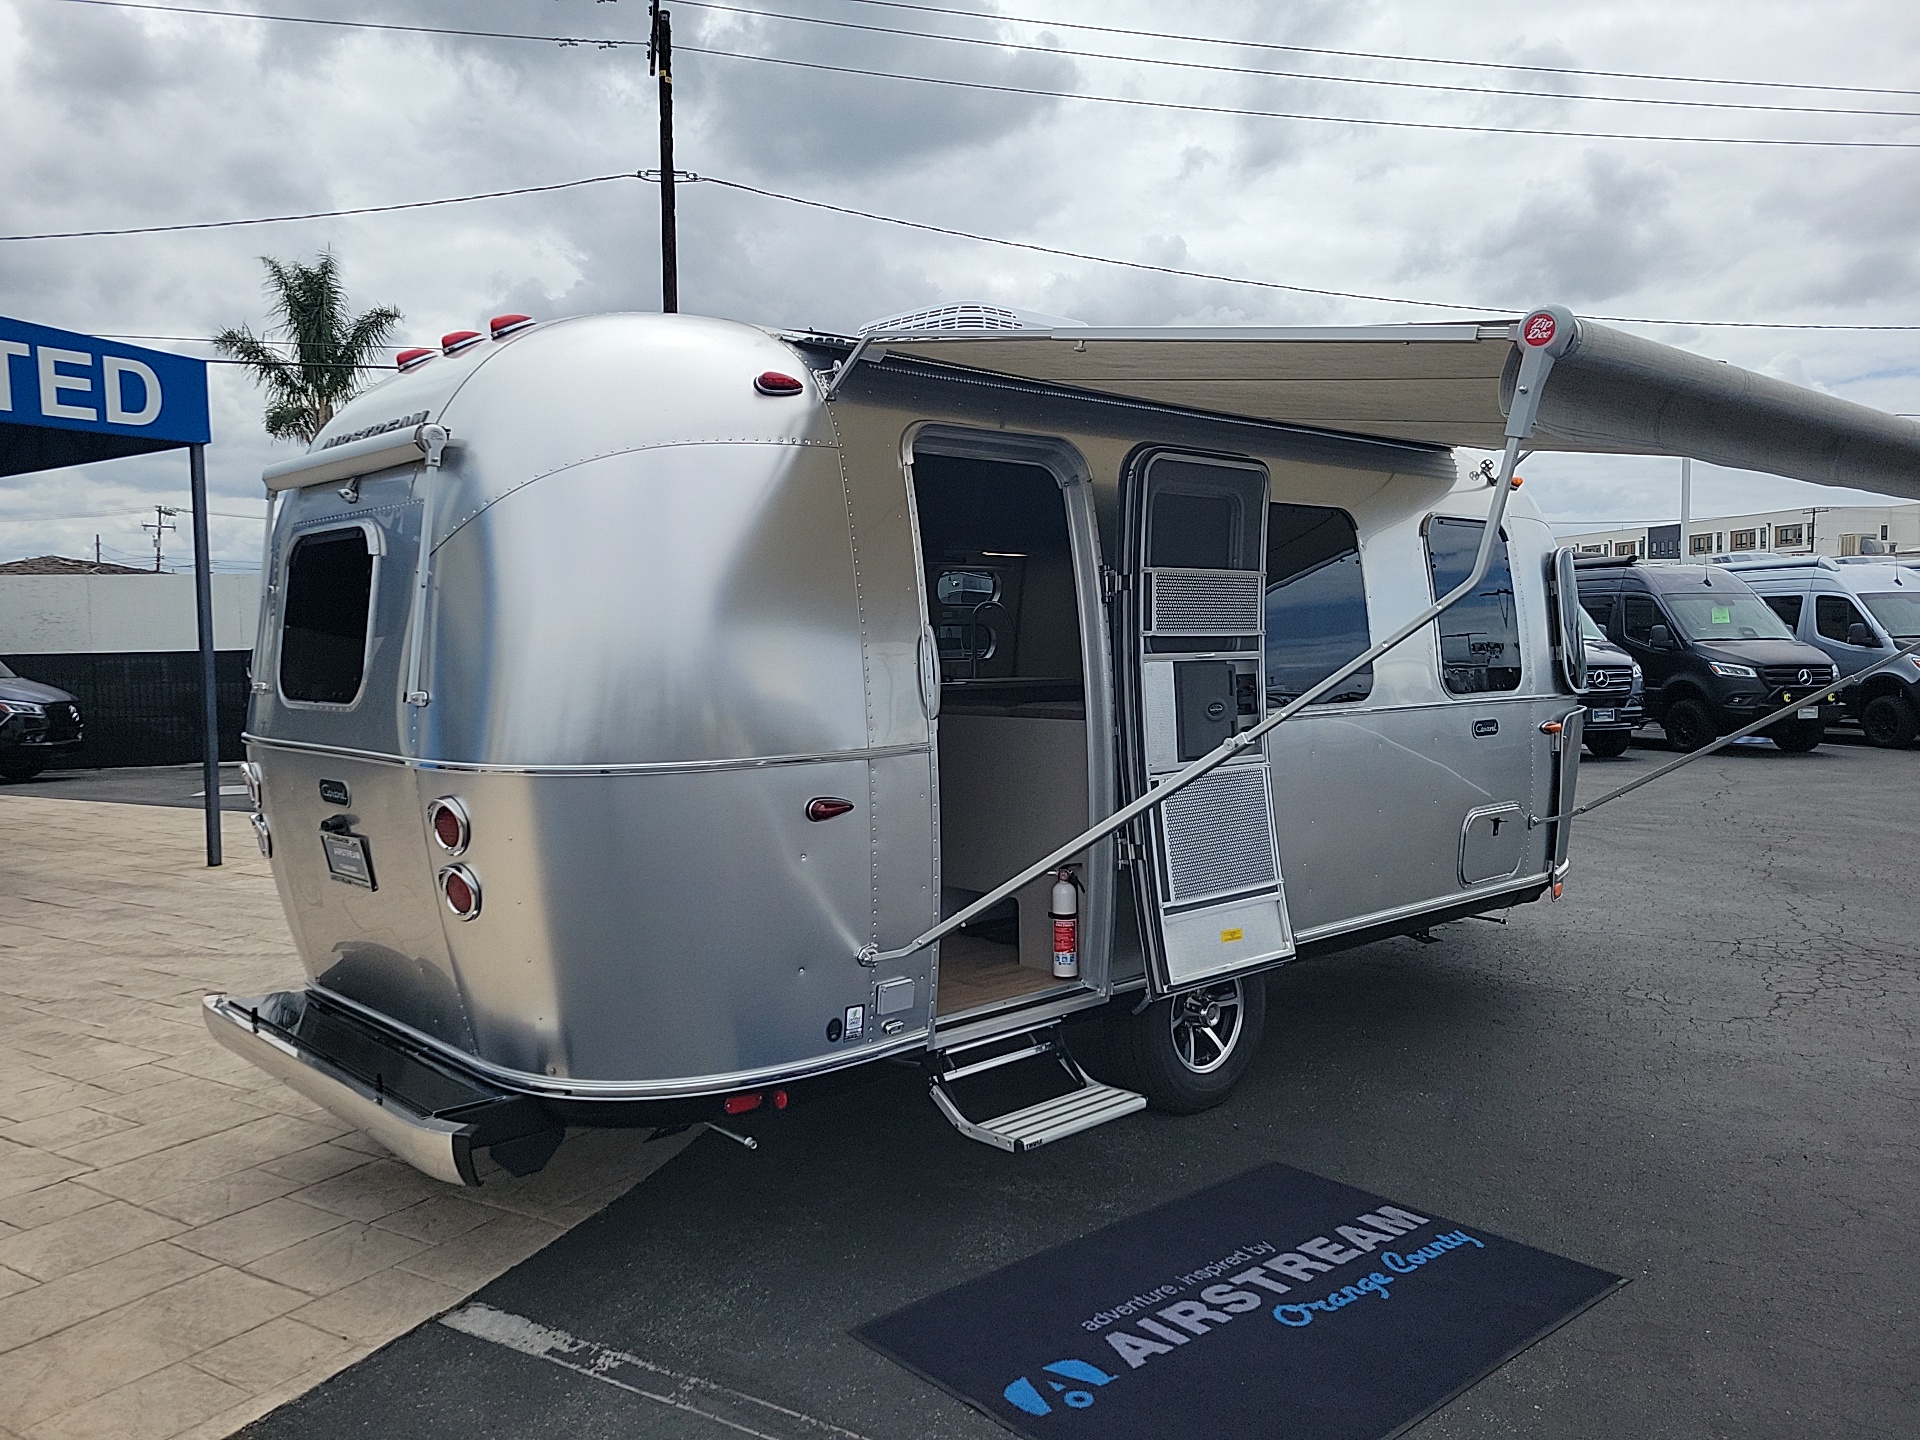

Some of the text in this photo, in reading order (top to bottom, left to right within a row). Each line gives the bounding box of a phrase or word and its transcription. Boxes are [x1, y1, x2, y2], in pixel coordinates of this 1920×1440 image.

[1527, 328, 1551, 339] Dee
[1531, 317, 1554, 331] Zip
[1081, 1240, 1276, 1331] adventure, inspired by
[1105, 1205, 1431, 1369] AIRSTREAM
[1272, 1229, 1485, 1327] Orange County
